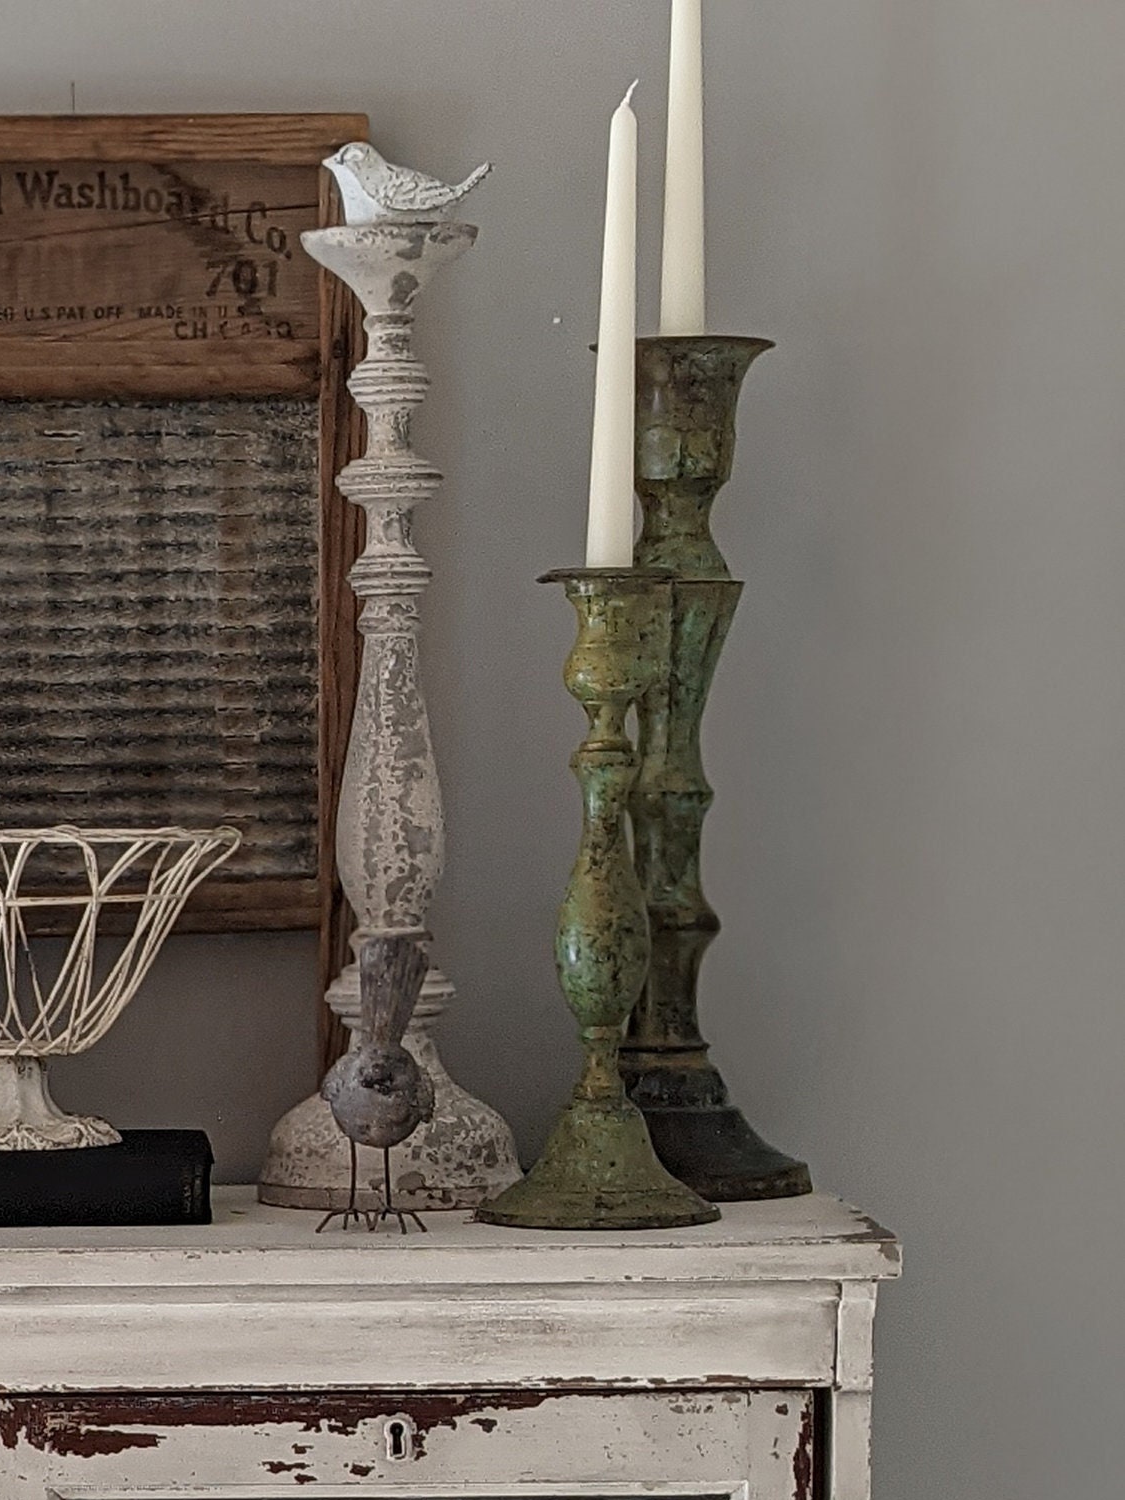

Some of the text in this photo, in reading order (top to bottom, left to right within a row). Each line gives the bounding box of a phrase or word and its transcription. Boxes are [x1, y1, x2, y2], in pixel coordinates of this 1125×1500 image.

[205, 258, 279, 298] 701
[138, 304, 183, 320] MADE
[175, 320, 294, 341] CHCAO
